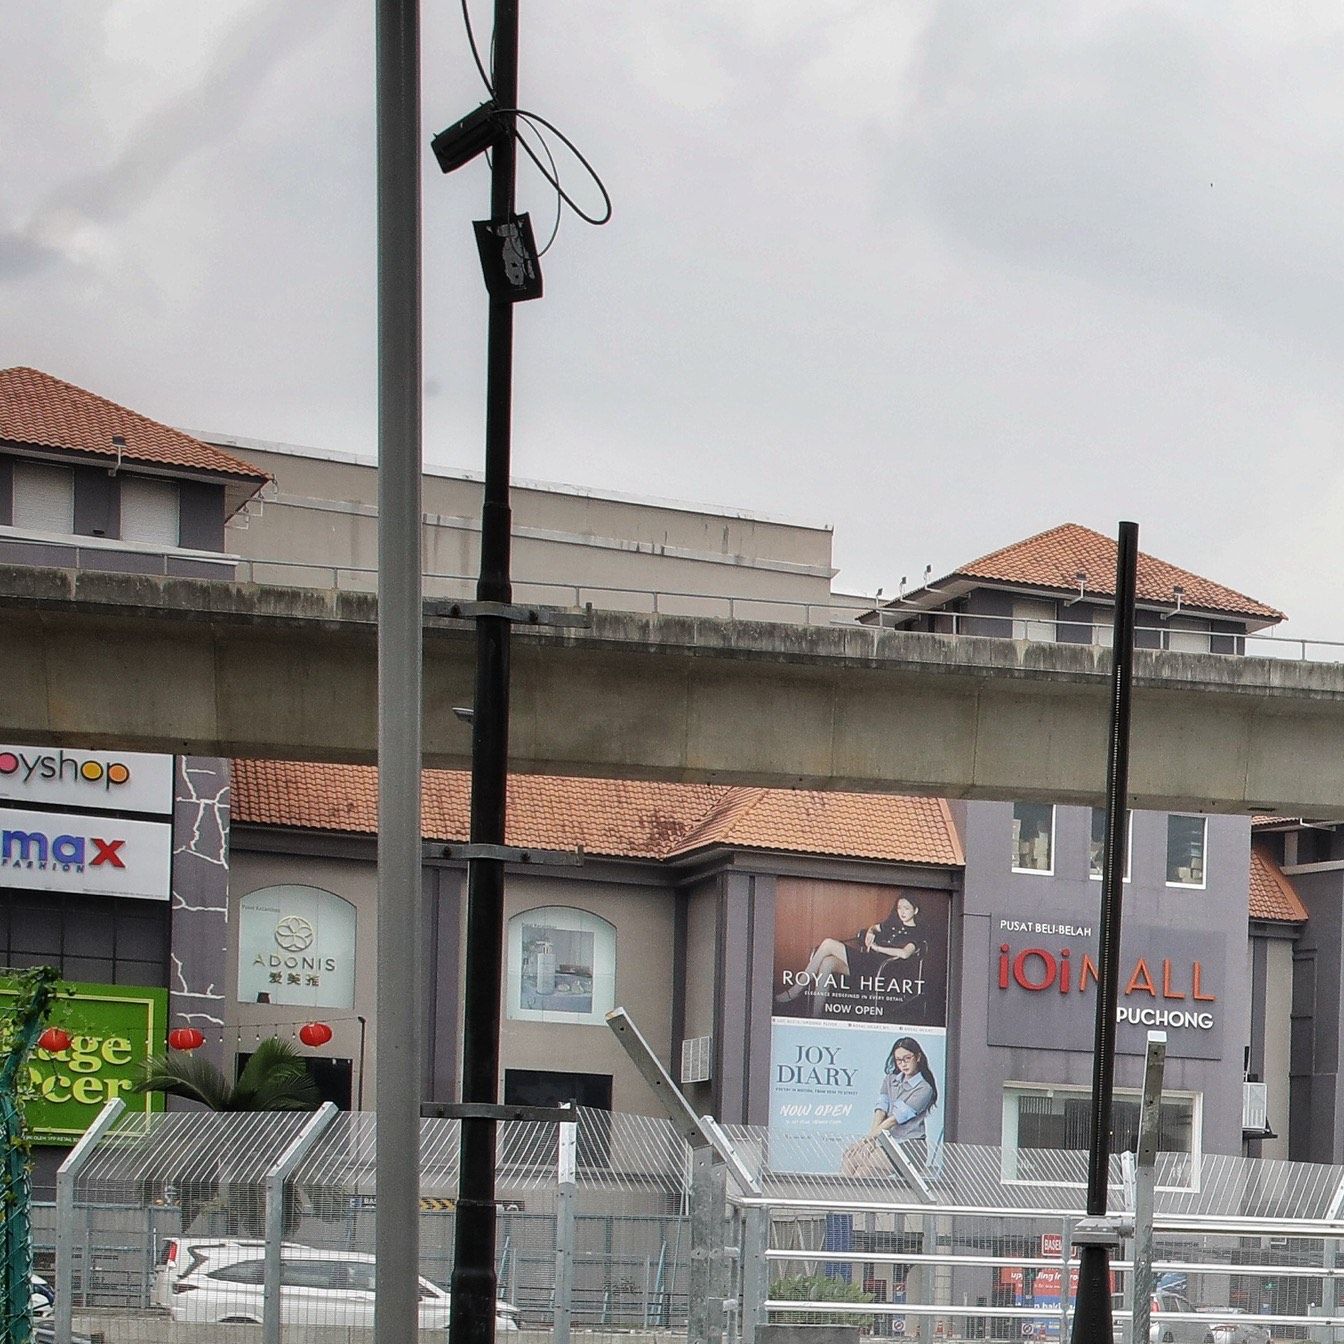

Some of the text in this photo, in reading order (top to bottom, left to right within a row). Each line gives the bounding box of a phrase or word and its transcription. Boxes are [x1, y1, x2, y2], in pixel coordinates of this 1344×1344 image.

[2, 829, 126, 869] max
[1, 858, 86, 874] FASHION
[1000, 919, 1092, 937] PUSAT BELI-BELAH
[253, 953, 336, 972] ADONIS
[782, 970, 926, 995] ROYAL HEART
[804, 990, 830, 998] ELEGANCE
[824, 1003, 884, 1016] NOW OPEN
[1116, 1007, 1214, 1029] PUCHONG
[795, 1045, 842, 1066] JOY
[777, 1065, 858, 1087] DIARY
[779, 1103, 853, 1117] NOW OPEN
